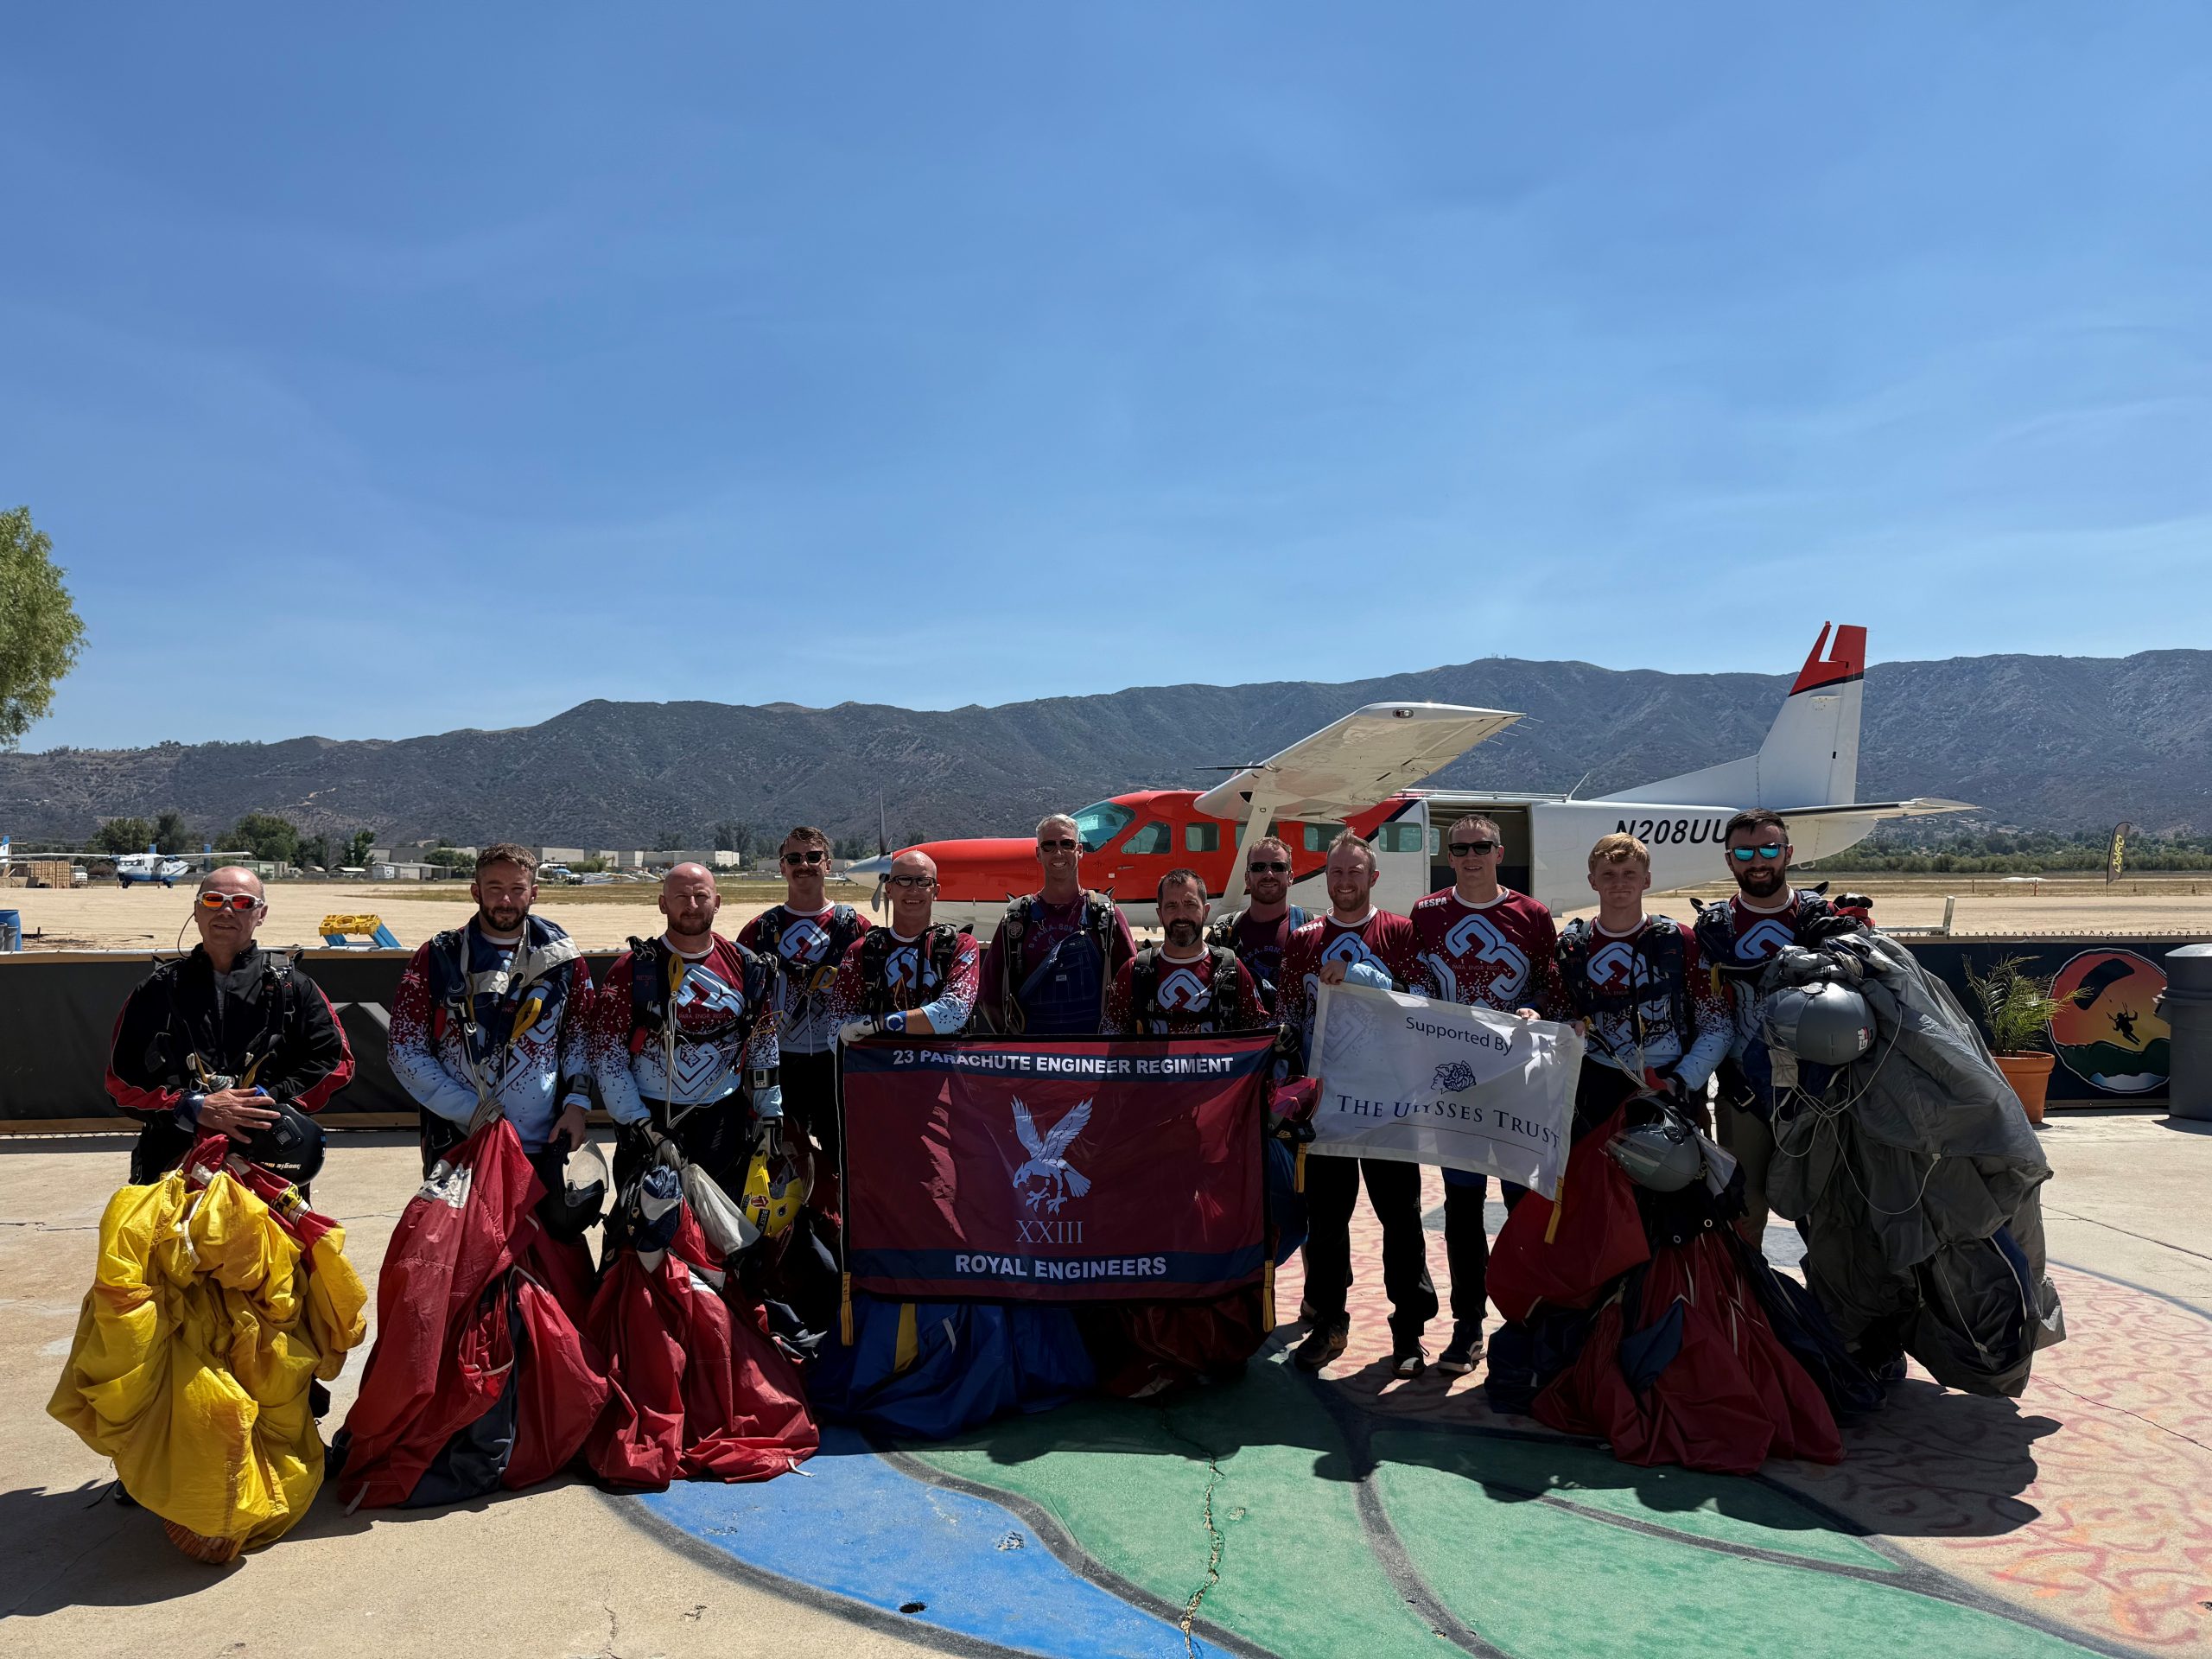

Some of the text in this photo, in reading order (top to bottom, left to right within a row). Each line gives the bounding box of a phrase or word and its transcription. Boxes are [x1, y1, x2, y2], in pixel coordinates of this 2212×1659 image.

[1405, 1016, 1513, 1056] Supported By
[893, 1049, 1234, 1074] 23 PARACHUTE ENGINEER REGIMENT
[1337, 1094, 1382, 1117] THE
[1492, 1109, 1560, 1148] TRUST
[1015, 1219, 1084, 1244] XXIII
[955, 1254, 1166, 1280] ROYAL ENGINEERS
